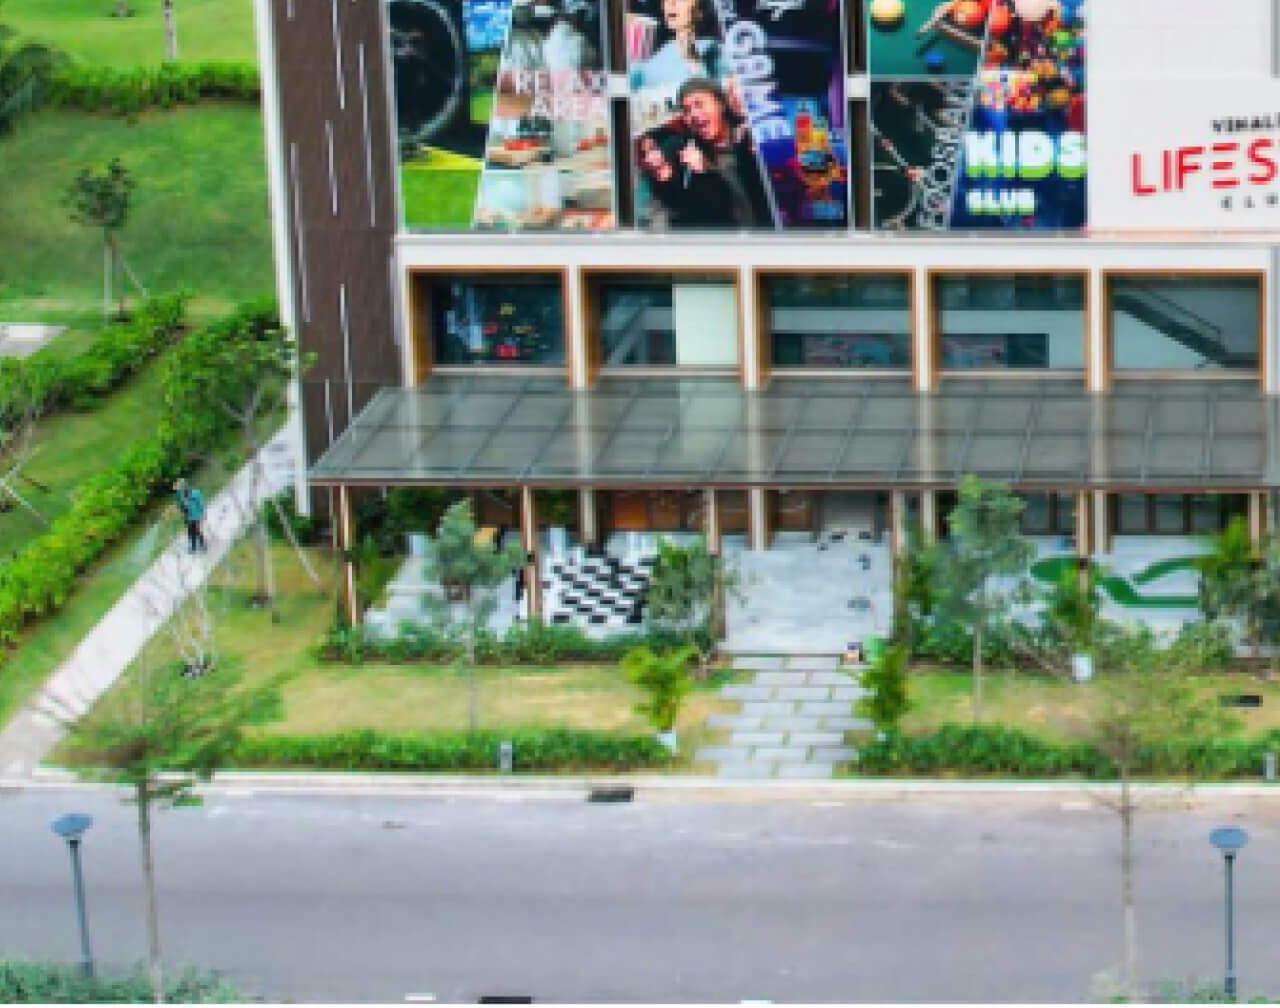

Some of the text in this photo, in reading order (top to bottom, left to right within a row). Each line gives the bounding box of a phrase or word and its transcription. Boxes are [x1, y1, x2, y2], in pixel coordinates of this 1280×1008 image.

[724, 21, 793, 143] GAME
[963, 130, 1088, 179] KIDS
[965, 188, 1036, 216] CLUB
